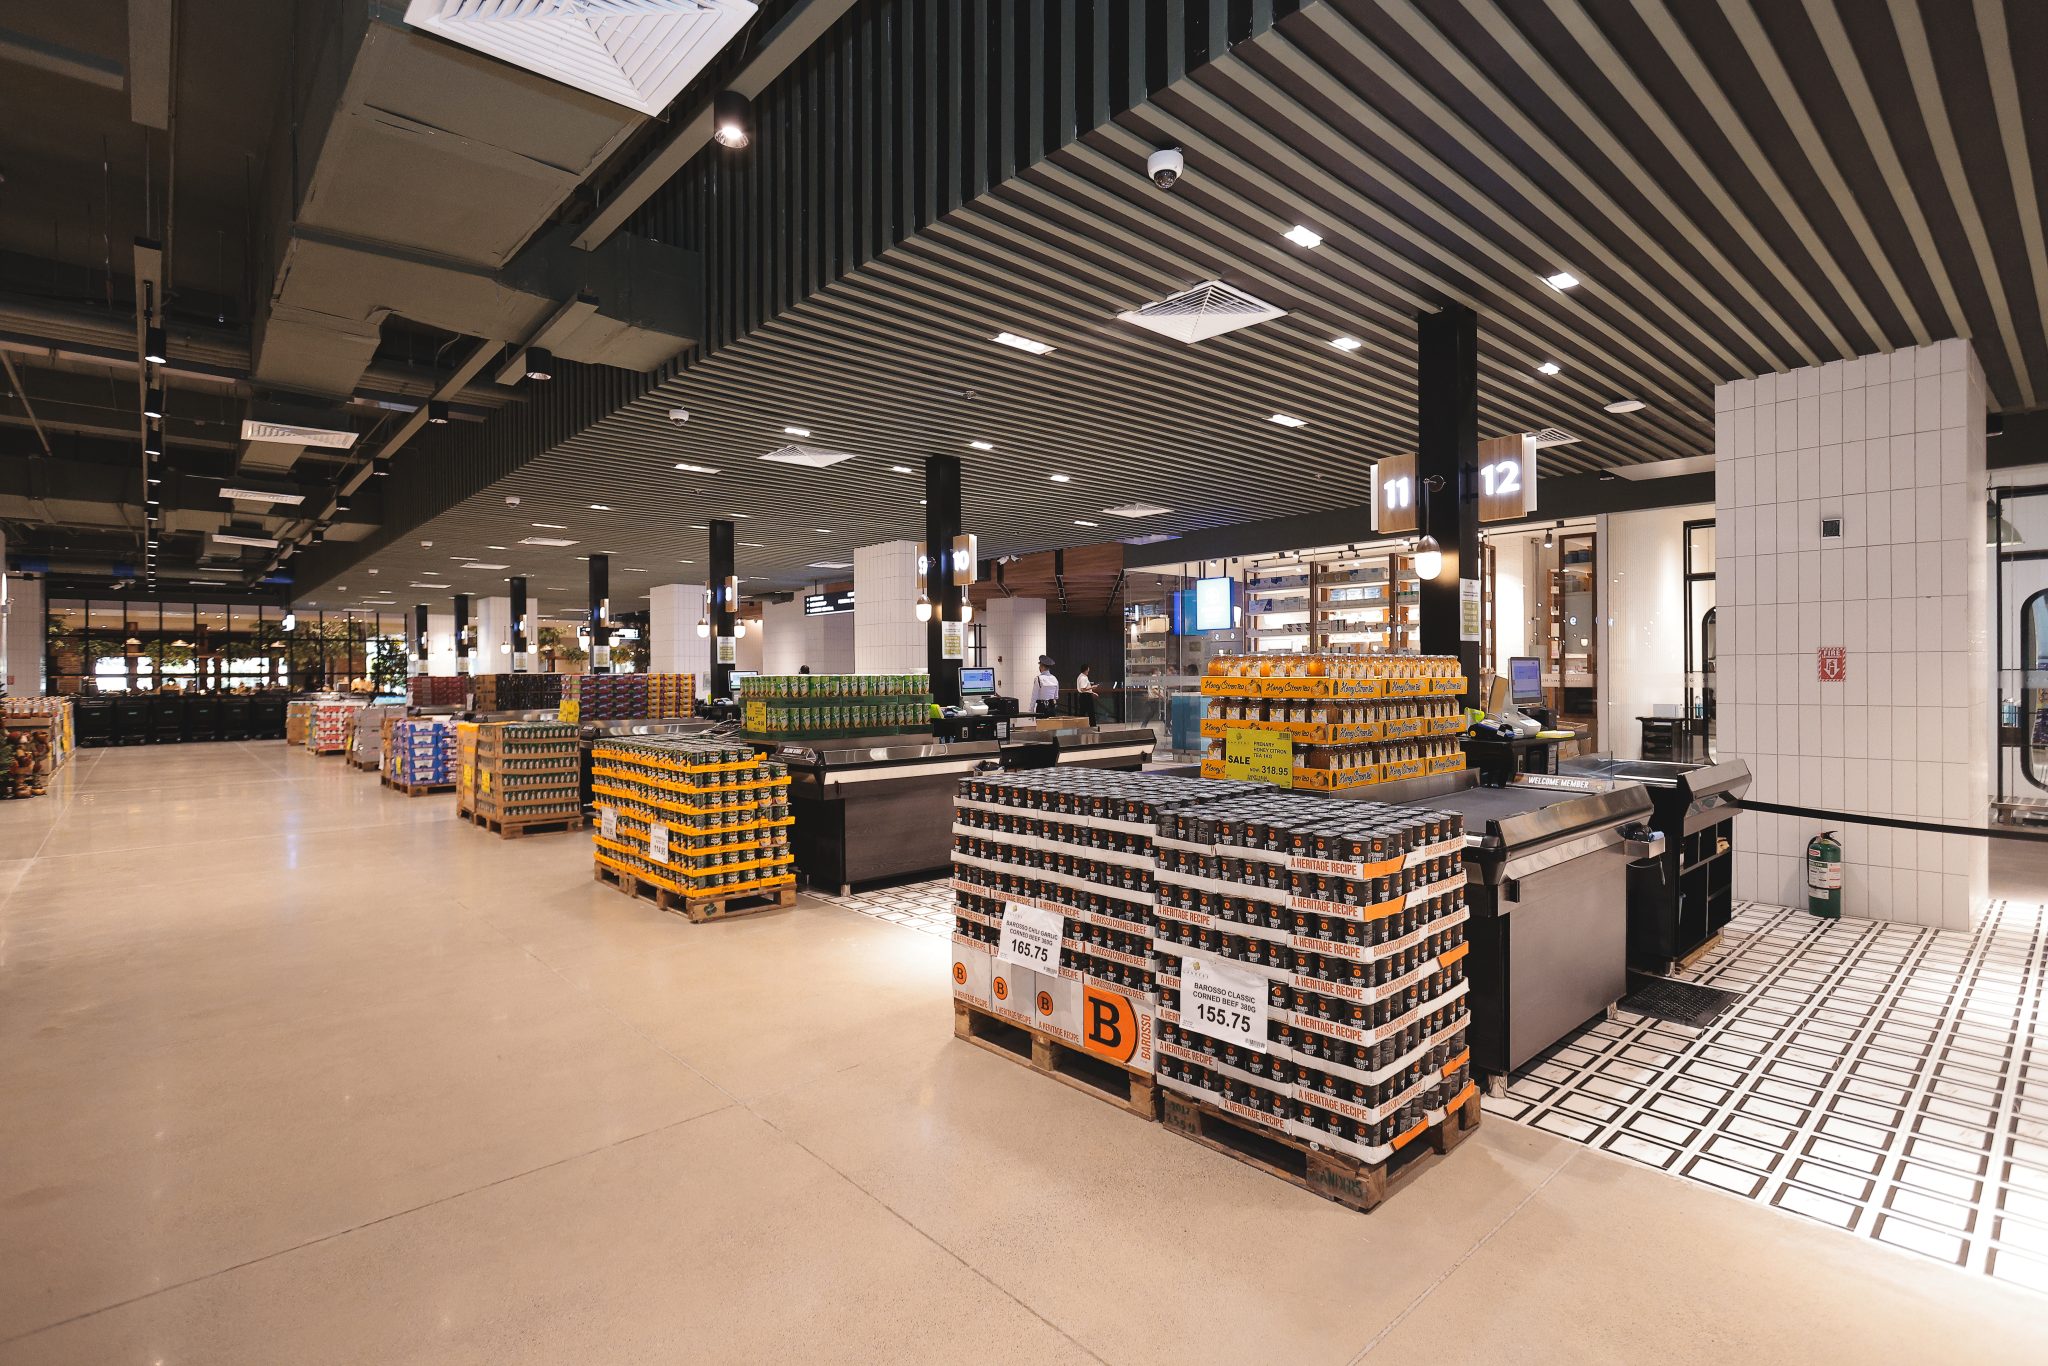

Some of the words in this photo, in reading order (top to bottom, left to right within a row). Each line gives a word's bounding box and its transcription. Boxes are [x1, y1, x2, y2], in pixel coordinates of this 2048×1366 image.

[1480, 460, 1520, 495] 12
[1383, 476, 1408, 509] 11
[918, 555, 928, 574] 9
[952, 550, 969, 571] 10
[1823, 649, 1841, 657] FIRE
[1204, 680, 1220, 691] Honey
[1221, 680, 1238, 690] Citron
[1266, 683, 1284, 694] Honey
[1284, 682, 1302, 692] Citron
[1204, 722, 1220, 734] Honey
[1205, 764, 1221, 774] Honey
[1228, 755, 1250, 765] SALE
[1262, 766, 1288, 776] 318.95
[1528, 776, 1560, 786] WELCOME
[1560, 779, 1589, 788] MEMBER
[1291, 858, 1296, 868] A
[1296, 859, 1329, 872] HERITAGE
[1332, 863, 1357, 876] RECIPE
[1158, 904, 1162, 912] A
[1162, 905, 1189, 920] HERITAGE
[1189, 913, 1210, 926] RECIPE
[1292, 897, 1296, 906] A
[1298, 898, 1330, 912] HERITAGE
[1333, 904, 1358, 917] RECIPE
[1007, 920, 1027, 931] BAROSSO
[1029, 926, 1040, 935] CHILI
[1041, 931, 1058, 940] GARLIC
[1090, 914, 1112, 927] BAROSSO
[1010, 929, 1028, 938] CORNED
[1011, 938, 1048, 962] 165.75
[1293, 936, 1298, 946] A
[1299, 937, 1332, 953] HERITAGE
[1334, 943, 1360, 958] RECIPE
[956, 968, 963, 980] B
[1160, 975, 1165, 984] A
[1165, 976, 1181, 989] HERIT
[997, 982, 1004, 994] B
[1194, 982, 1226, 996] BAROSSO
[1228, 990, 1256, 1004] CLASSIC
[1295, 975, 1300, 986] A
[1301, 976, 1334, 994] HERITAGE
[1336, 985, 1363, 1000] RECIPE
[1041, 997, 1049, 1010] B
[1192, 990, 1221, 1003] CORNED
[1222, 998, 1239, 1008] BEEF
[1088, 996, 1121, 1048] B
[1160, 1009, 1164, 1018] A
[1165, 1011, 1180, 1023] HERIT
[1197, 1003, 1250, 1032] 155.75
[1042, 1023, 1063, 1036] HERITAGE
[1063, 1030, 1079, 1043] RECIPE
[1141, 1014, 1152, 1060] BAROSSO
[1295, 1014, 1300, 1025] A
[1301, 1016, 1334, 1034] HERITAGE
[1336, 1025, 1363, 1042] RECIPE
[1159, 1042, 1164, 1050] A
[1164, 1043, 1191, 1060] HERITAGE
[1192, 1053, 1213, 1066] RECIPE
[1224, 1100, 1228, 1109] A
[1229, 1102, 1260, 1120] HERITAGE
[1261, 1113, 1284, 1129] RECIPE
[1298, 1090, 1303, 1099] A
[1304, 1091, 1339, 1111] HERITAGE
[1340, 1102, 1367, 1120] RECIPE
